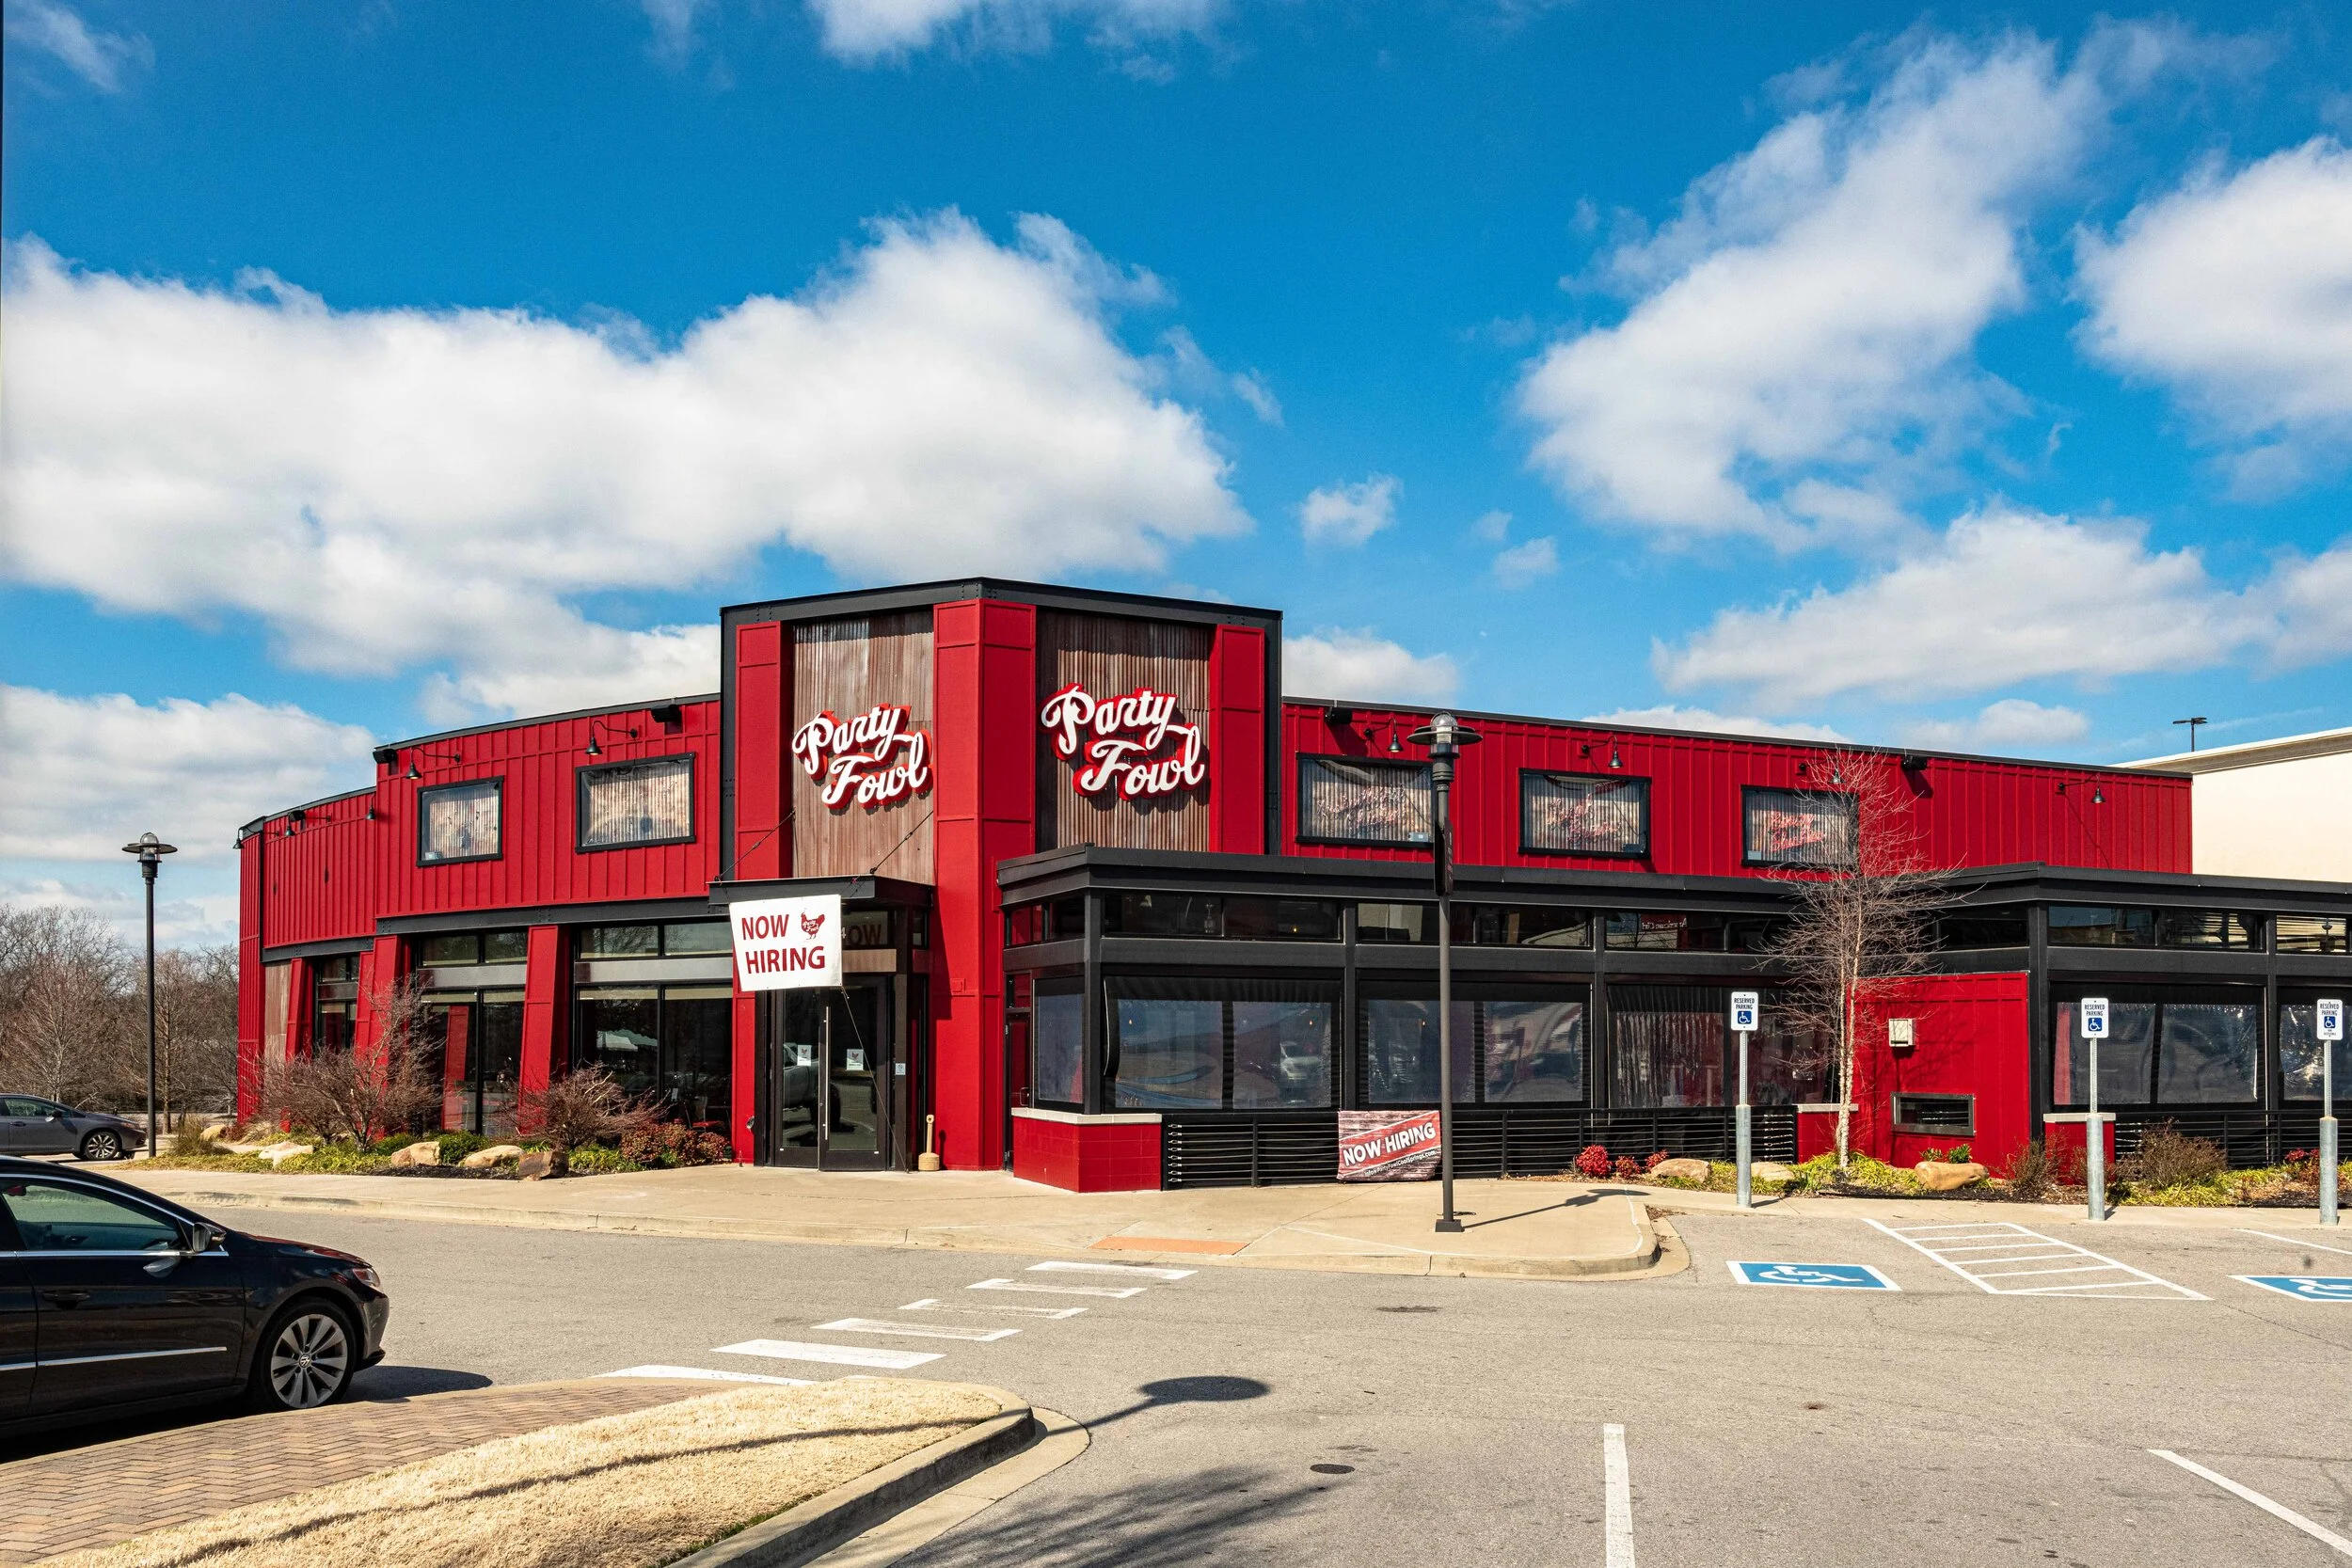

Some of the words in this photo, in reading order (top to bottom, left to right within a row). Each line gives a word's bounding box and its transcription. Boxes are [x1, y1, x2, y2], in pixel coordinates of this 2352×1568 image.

[791, 705, 901, 775] Party
[1041, 685, 1177, 754] Party
[821, 731, 929, 804] Fowl
[1080, 725, 1205, 795] Fowl
[741, 913, 789, 941] NOW
[745, 945, 826, 974] HIRING
[1343, 1139, 1381, 1166] NOW
[1385, 1122, 1437, 1153] HIRING
